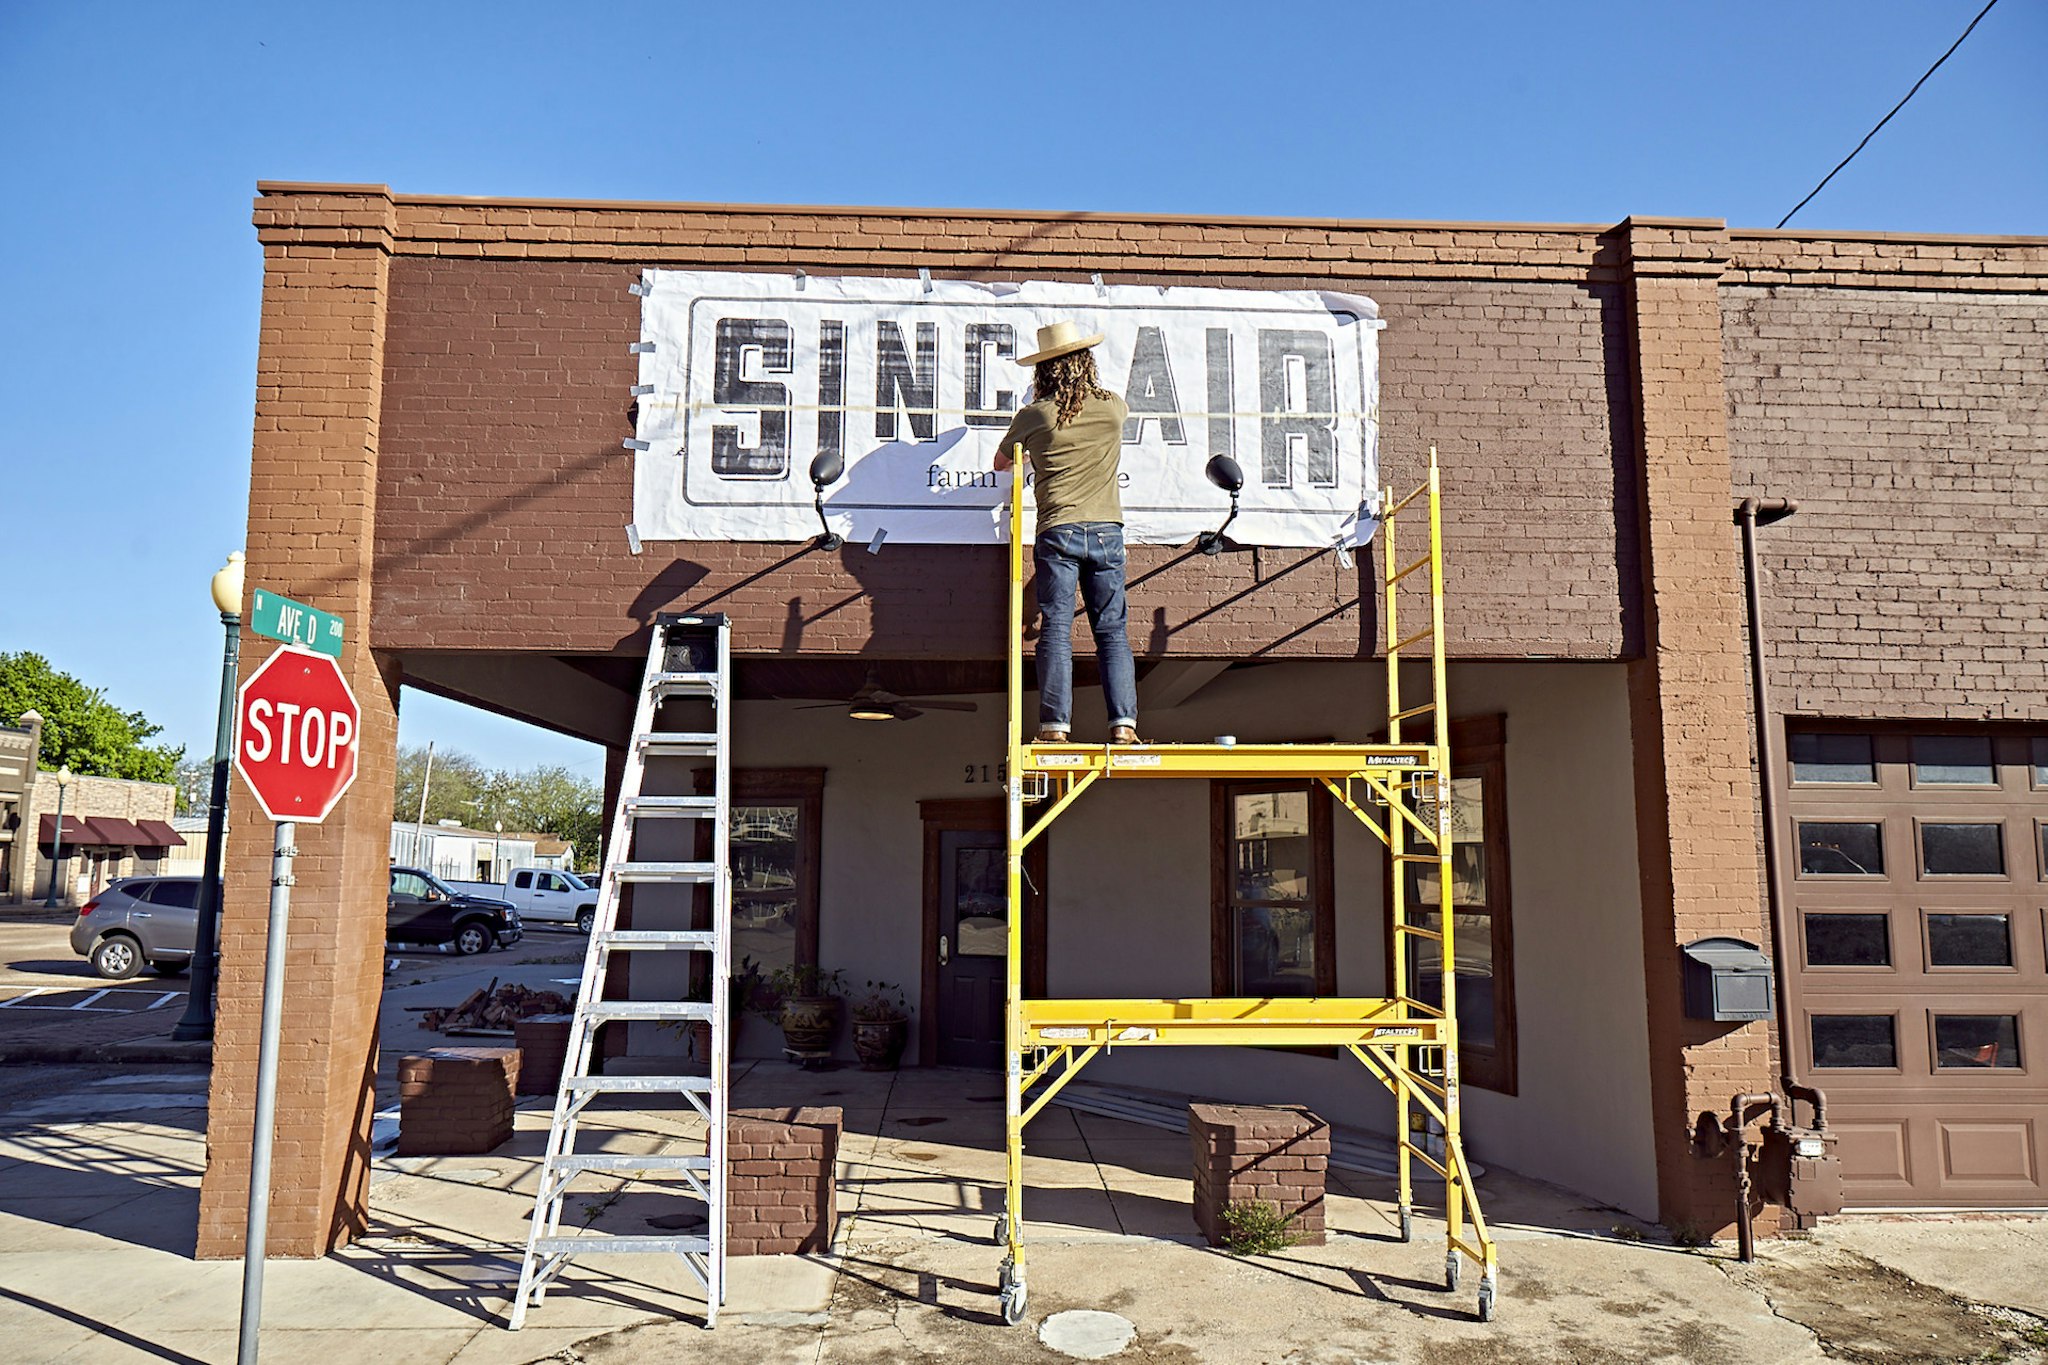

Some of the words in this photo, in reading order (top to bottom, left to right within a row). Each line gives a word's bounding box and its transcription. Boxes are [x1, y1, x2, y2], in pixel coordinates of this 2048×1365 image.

[711, 317, 1339, 489] SINCAIR
[926, 464, 998, 488] farm
[256, 594, 263, 611] N
[277, 604, 303, 640] AVE
[307, 614, 317, 645] D
[329, 619, 343, 638] 200
[245, 697, 353, 769] STOP
[964, 764, 1007, 783] 215
